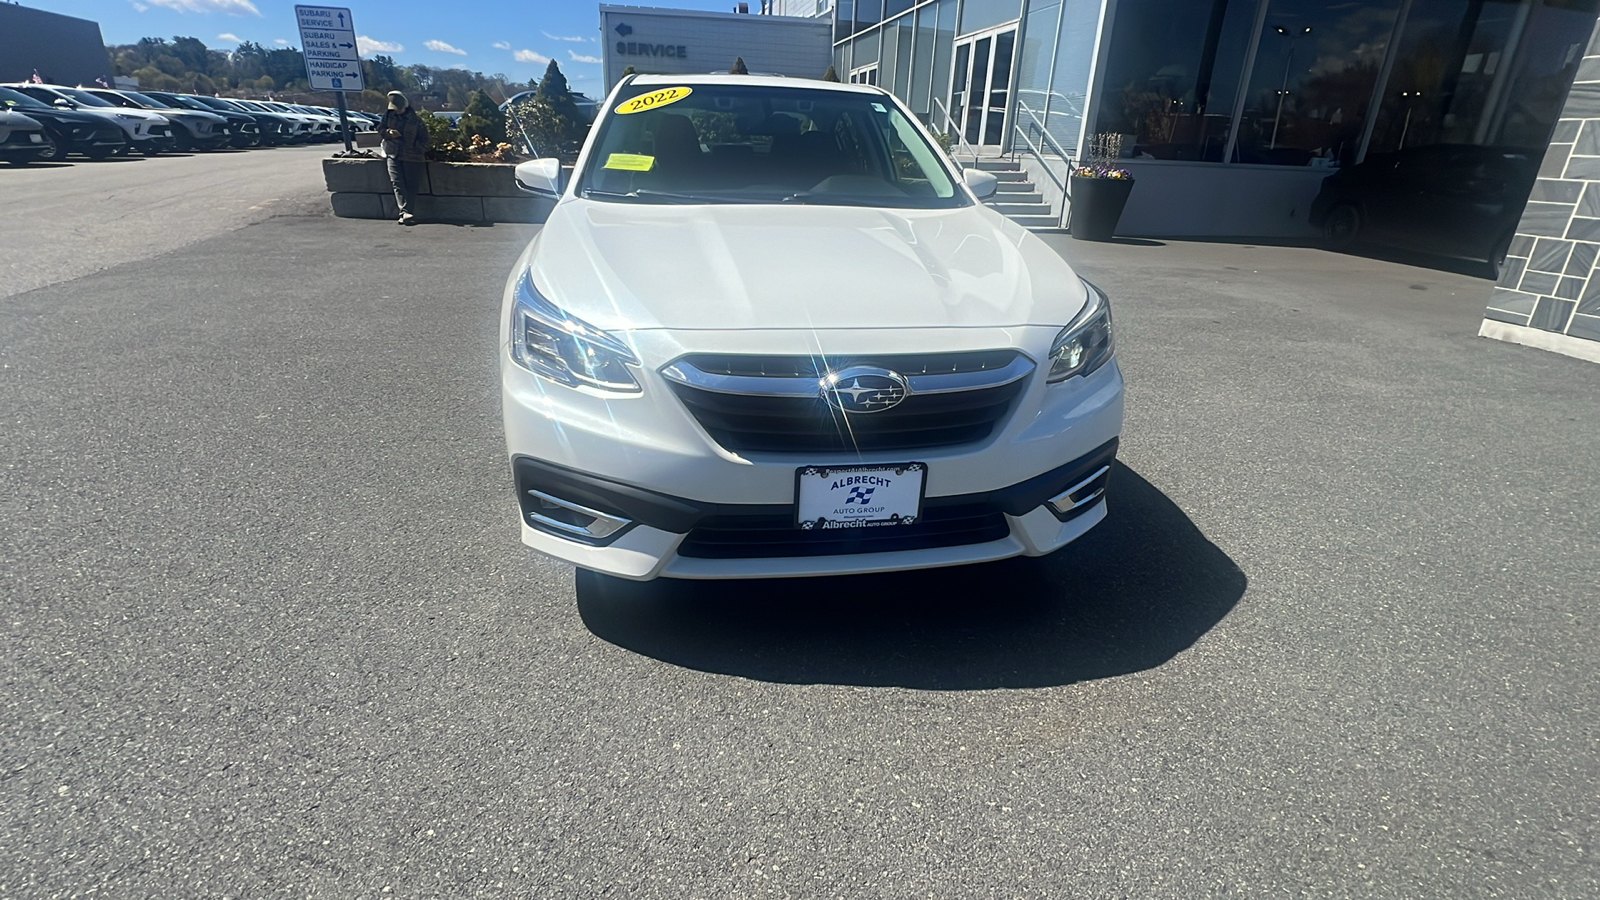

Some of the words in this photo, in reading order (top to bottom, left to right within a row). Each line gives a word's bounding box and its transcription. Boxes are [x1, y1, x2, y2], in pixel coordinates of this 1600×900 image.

[299, 9, 331, 18] SUBARU
[301, 19, 334, 27] SERVICE
[303, 32, 335, 40] SUBARU
[305, 41, 330, 49] SALES
[616, 41, 687, 58] SERVICE
[307, 50, 341, 58] PARKING
[310, 61, 347, 69] HANDICAP
[311, 70, 344, 78] PARKING
[630, 89, 679, 111] 2022
[830, 475, 891, 491] ALBRECHT
[856, 506, 885, 514] GROUP
[822, 520, 867, 529] Albrecht
